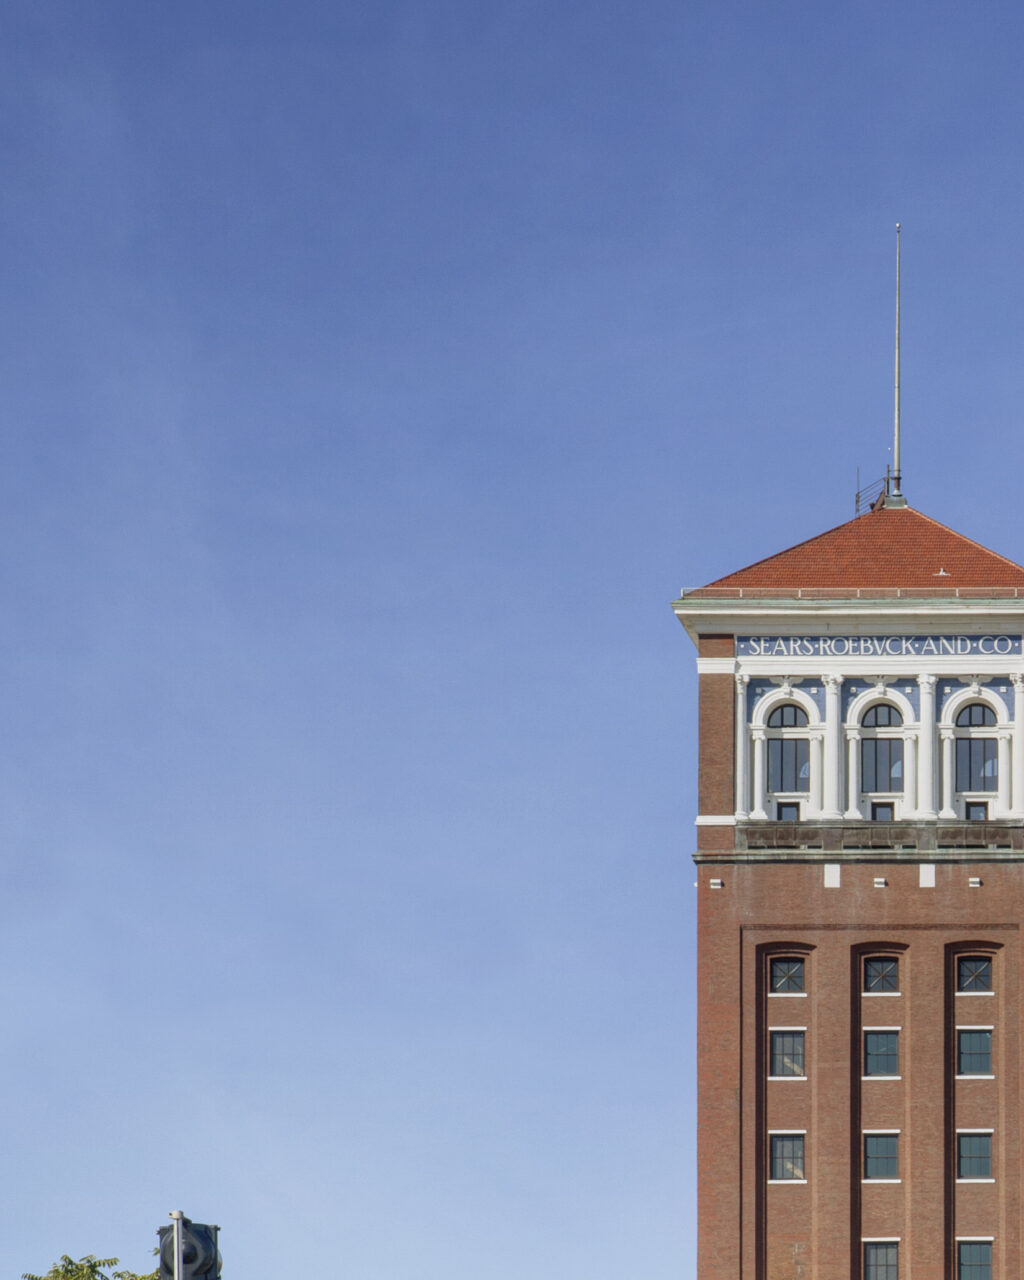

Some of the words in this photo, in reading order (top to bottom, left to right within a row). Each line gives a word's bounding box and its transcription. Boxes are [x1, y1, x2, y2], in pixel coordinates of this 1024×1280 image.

[748, 636, 814, 656] SEARS
[820, 636, 916, 656] ROEBVCK
[921, 635, 971, 655] AND
